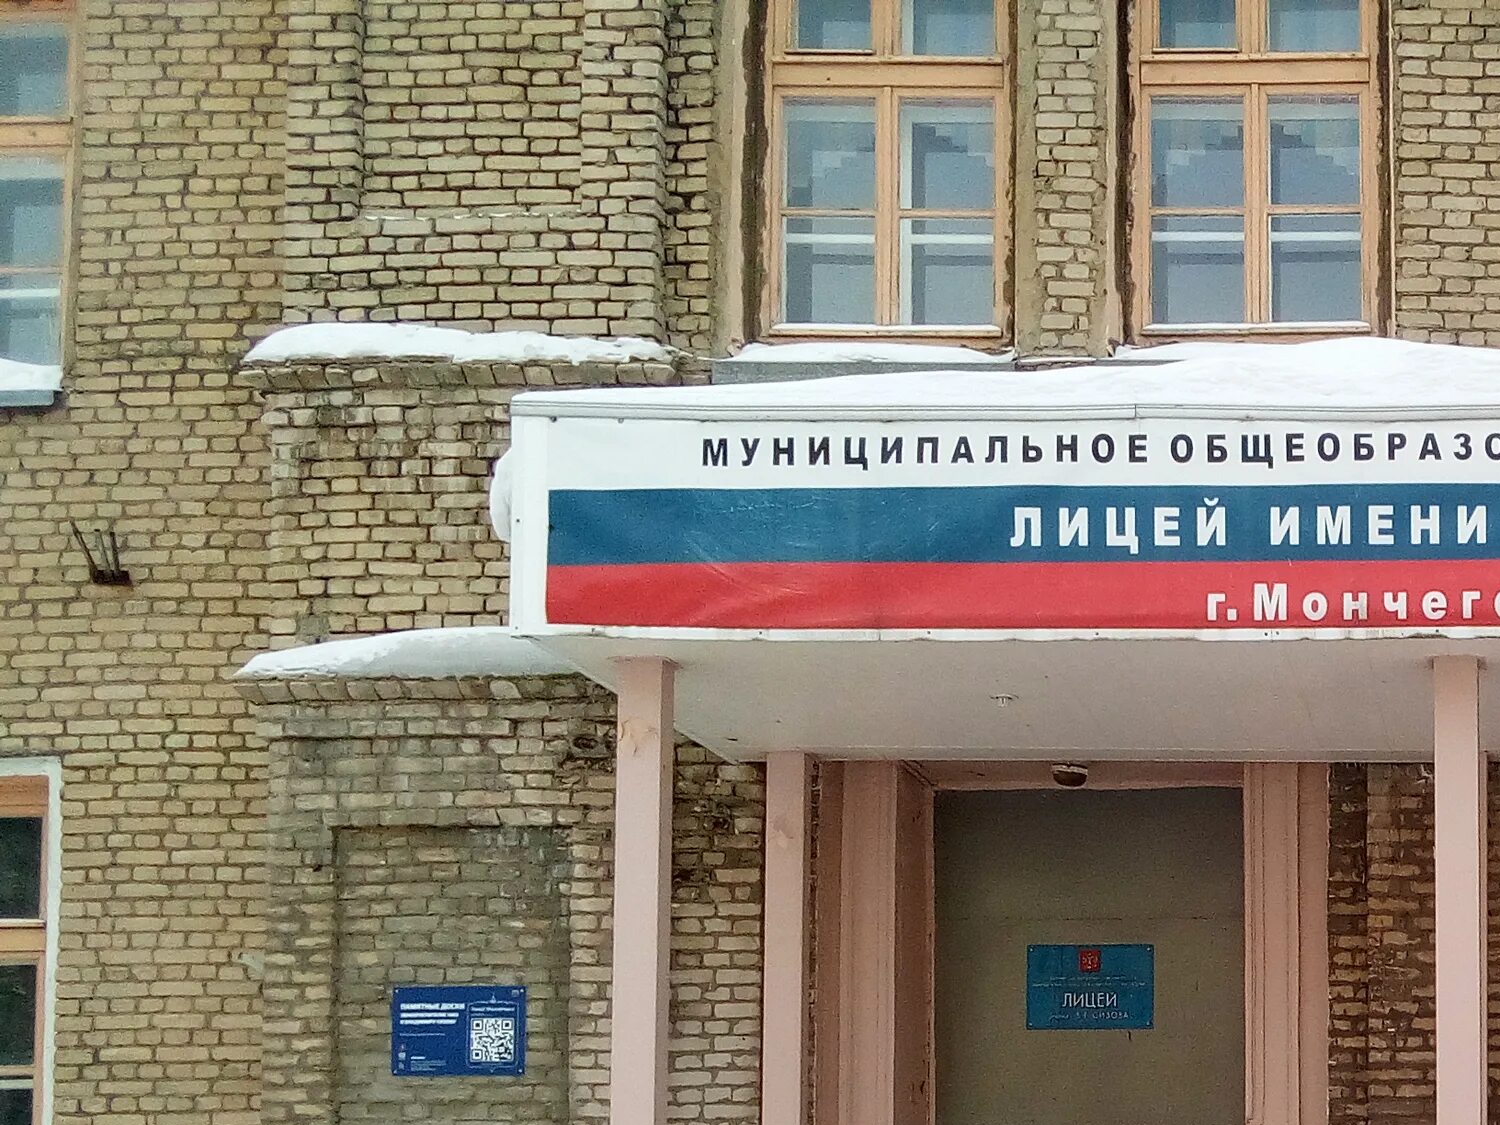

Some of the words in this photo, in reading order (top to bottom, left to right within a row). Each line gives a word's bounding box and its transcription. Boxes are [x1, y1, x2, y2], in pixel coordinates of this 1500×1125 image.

[702, 434, 1148, 471] МУНИЦИПАЛЬНОЕ
[1009, 497, 1227, 554] ЛИЦЕЙ
[1269, 504, 1487, 546] ИМЕНИ
[1062, 991, 1117, 1008] ЛИЦЕЙ
